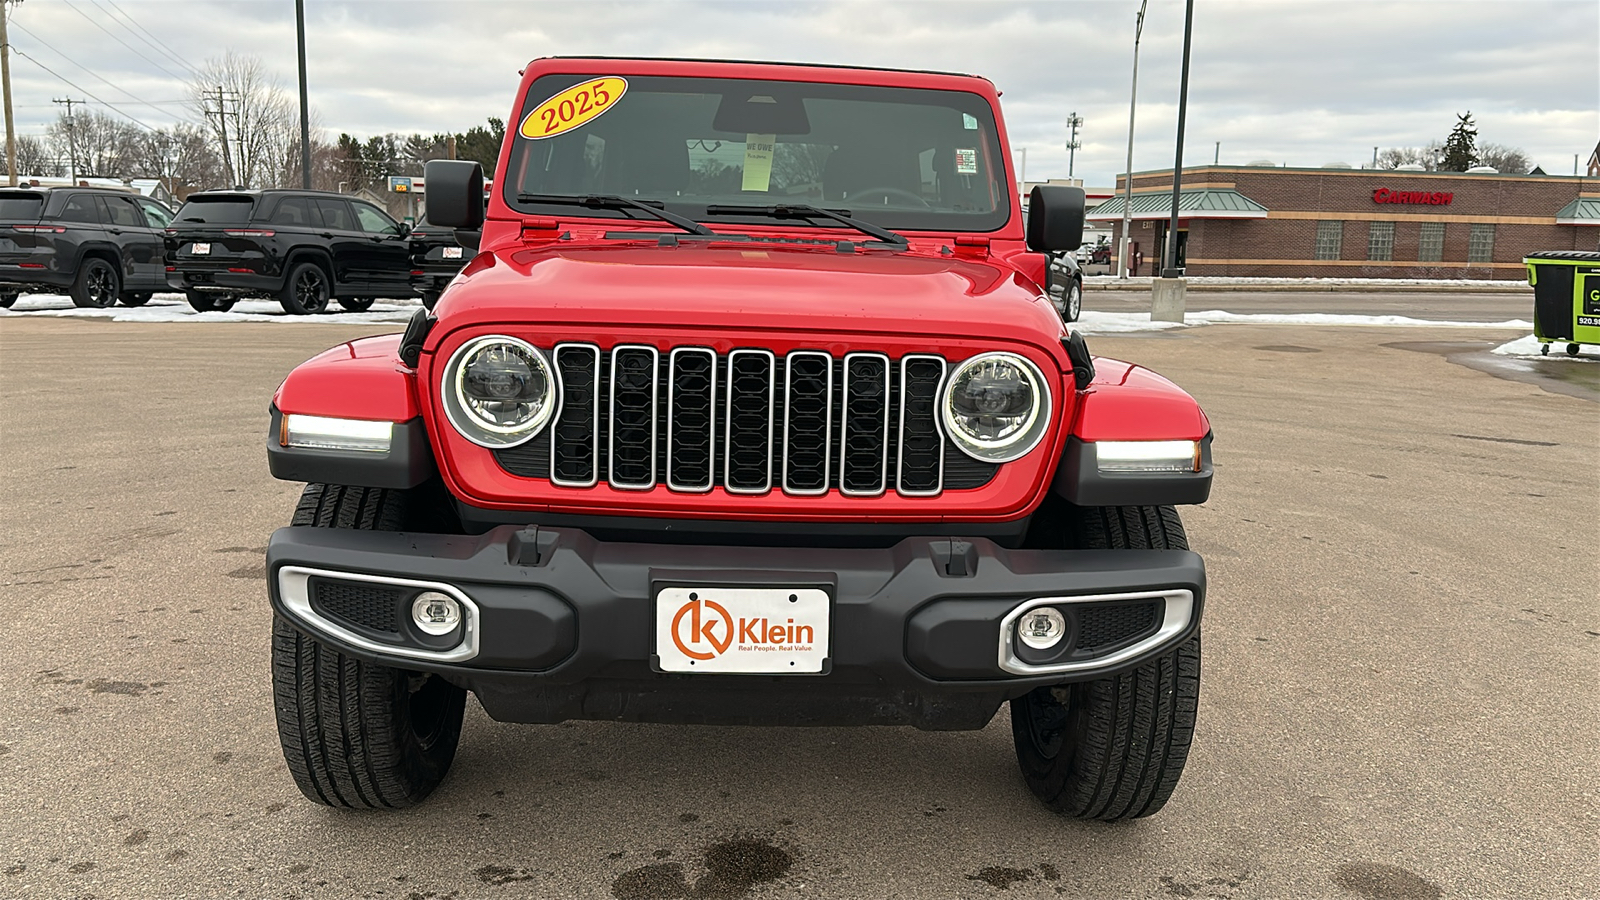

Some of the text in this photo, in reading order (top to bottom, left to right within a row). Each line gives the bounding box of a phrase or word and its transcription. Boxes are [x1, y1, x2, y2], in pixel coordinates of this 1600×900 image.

[541, 82, 610, 133] 2025
[757, 144, 773, 152] OWE
[1373, 187, 1454, 205] CARWASH
[738, 617, 814, 644] Klein
